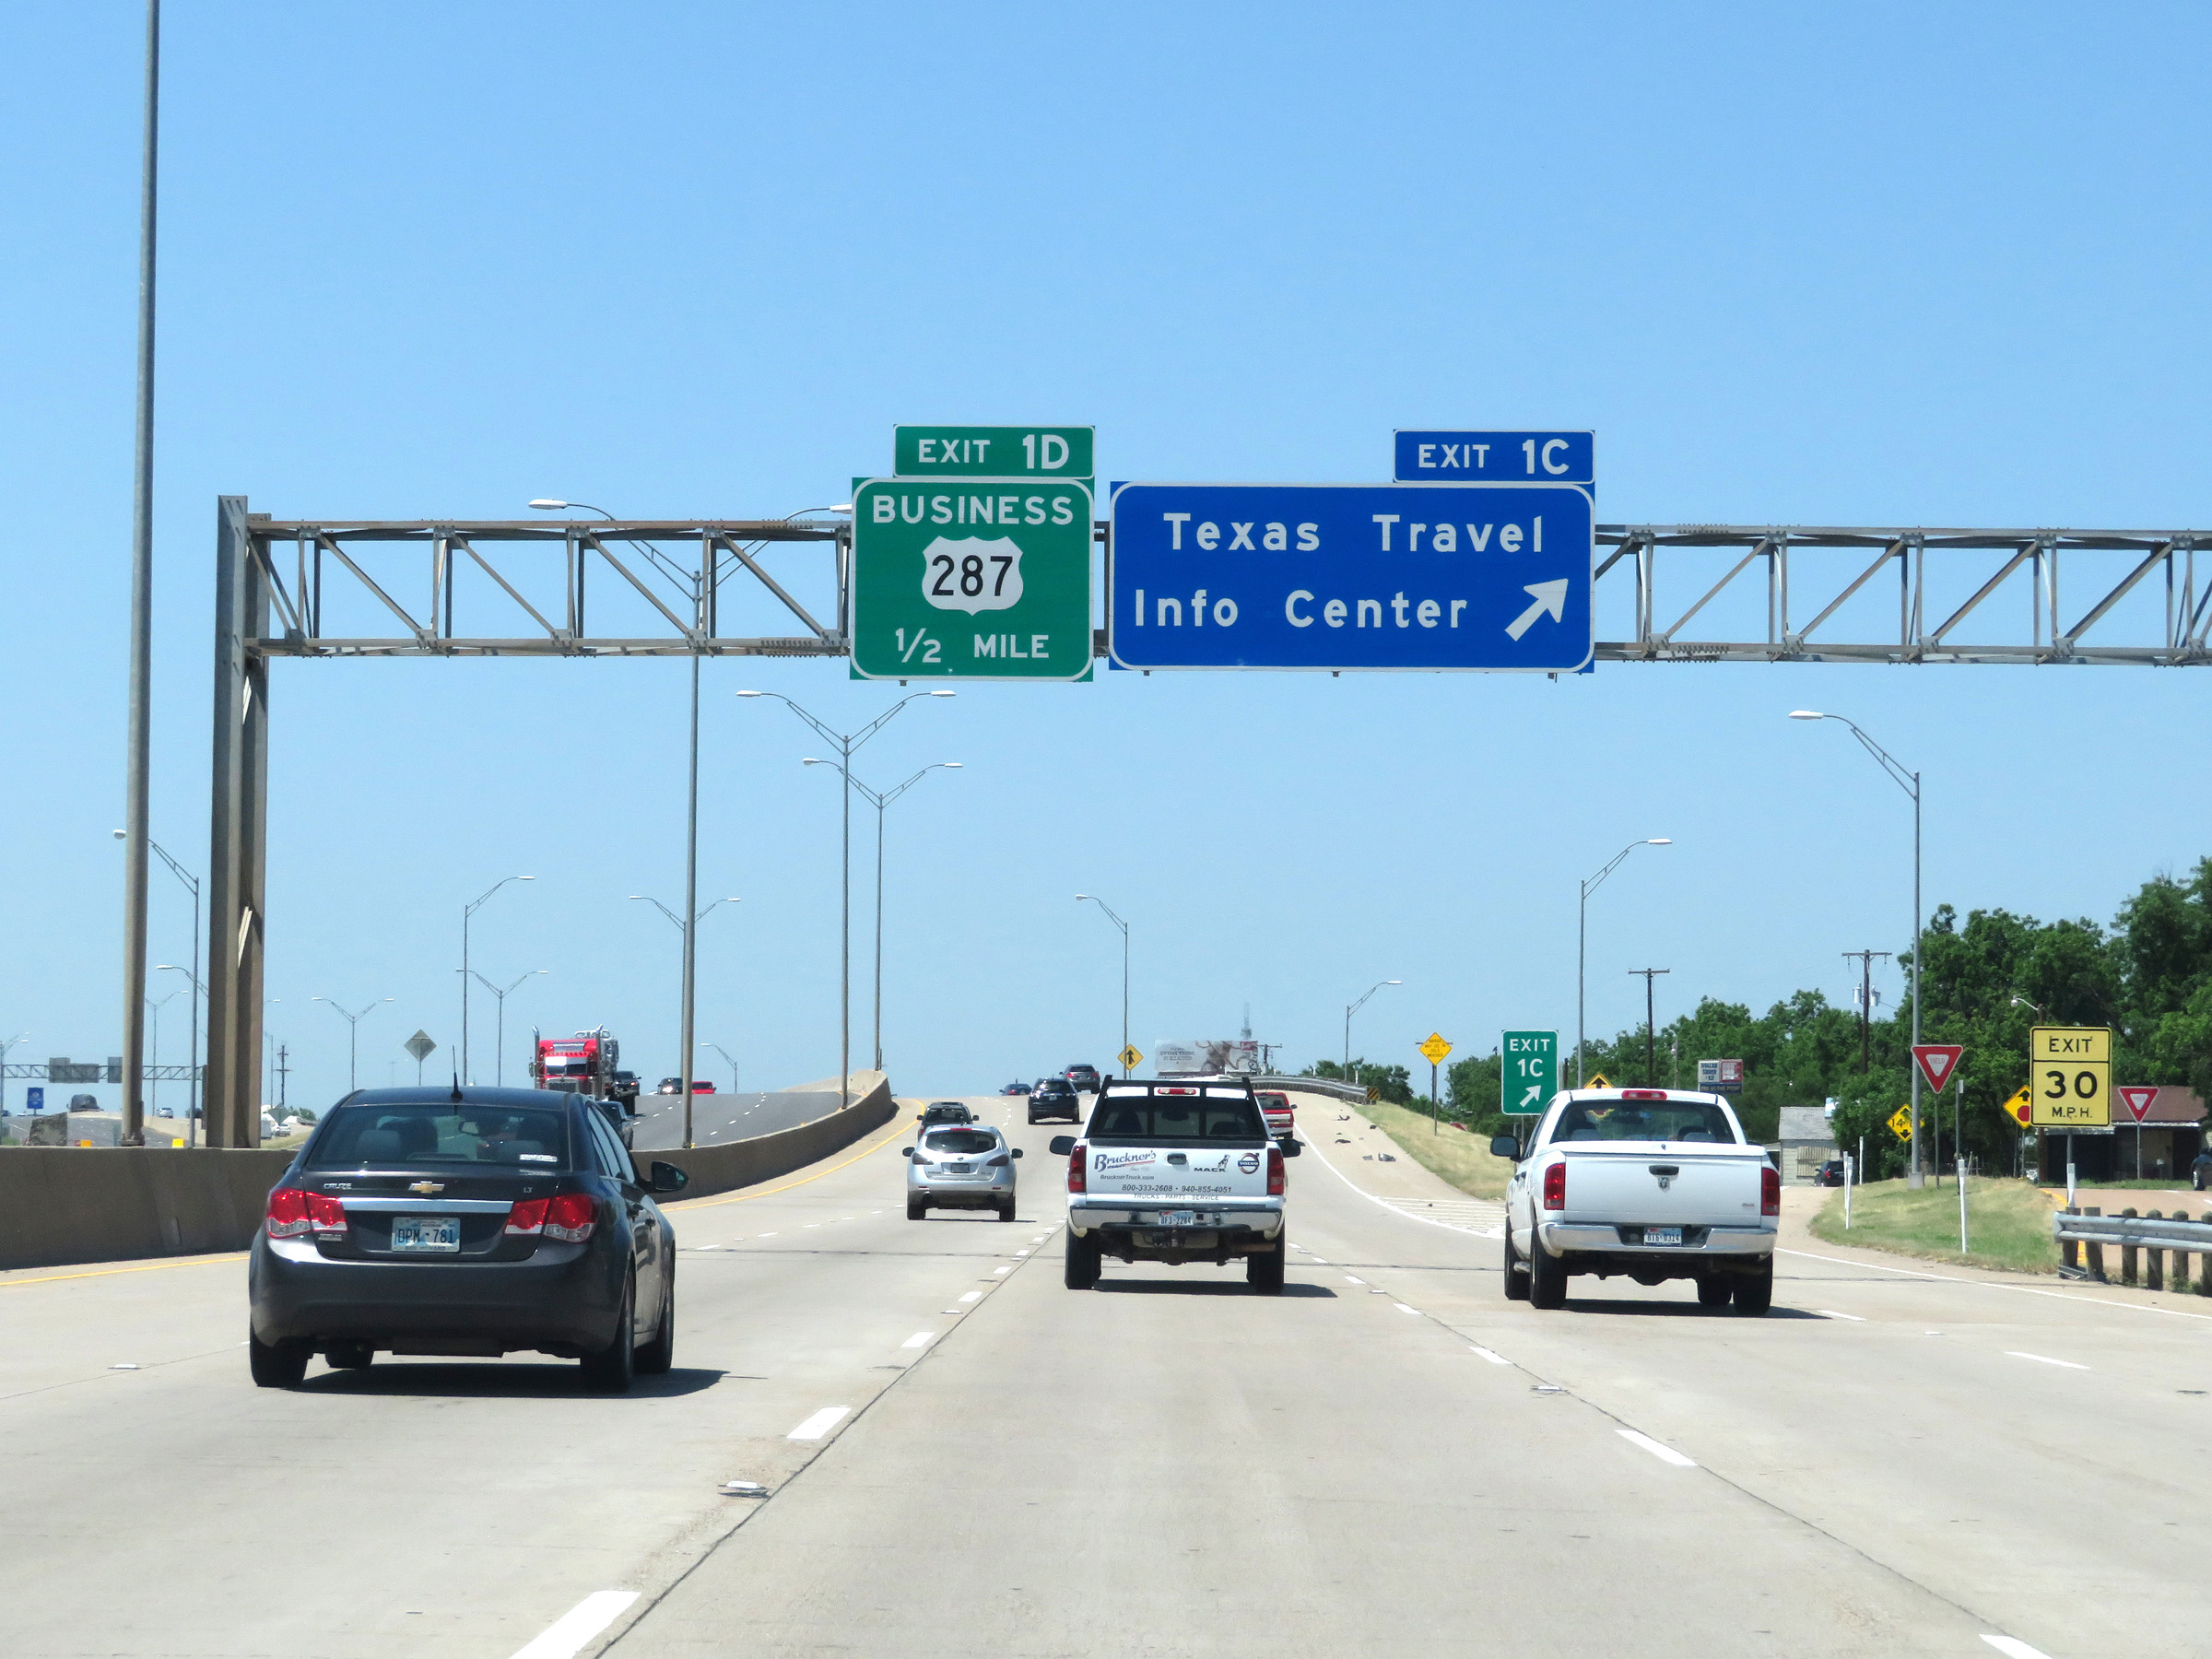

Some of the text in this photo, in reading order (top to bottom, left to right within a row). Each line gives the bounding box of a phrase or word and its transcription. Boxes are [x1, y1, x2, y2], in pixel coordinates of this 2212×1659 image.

[918, 434, 1070, 469] EXIT 1D
[1418, 439, 1570, 475] EXIT 1C
[873, 495, 1074, 525] BUSINESS
[1163, 512, 1542, 553] Texas Travel
[931, 554, 1014, 596] 287
[1135, 589, 1468, 629] Info Center
[895, 628, 1050, 663] 1/2 MILE
[1510, 1038, 1550, 1052] EXIT
[2049, 1038, 2092, 1053] EXIT
[1517, 1058, 1544, 1077] 1C
[2043, 1070, 2098, 1100] 30
[2052, 1106, 2093, 1118] M.P.H.
[1094, 1149, 1157, 1173] Bruckner's
